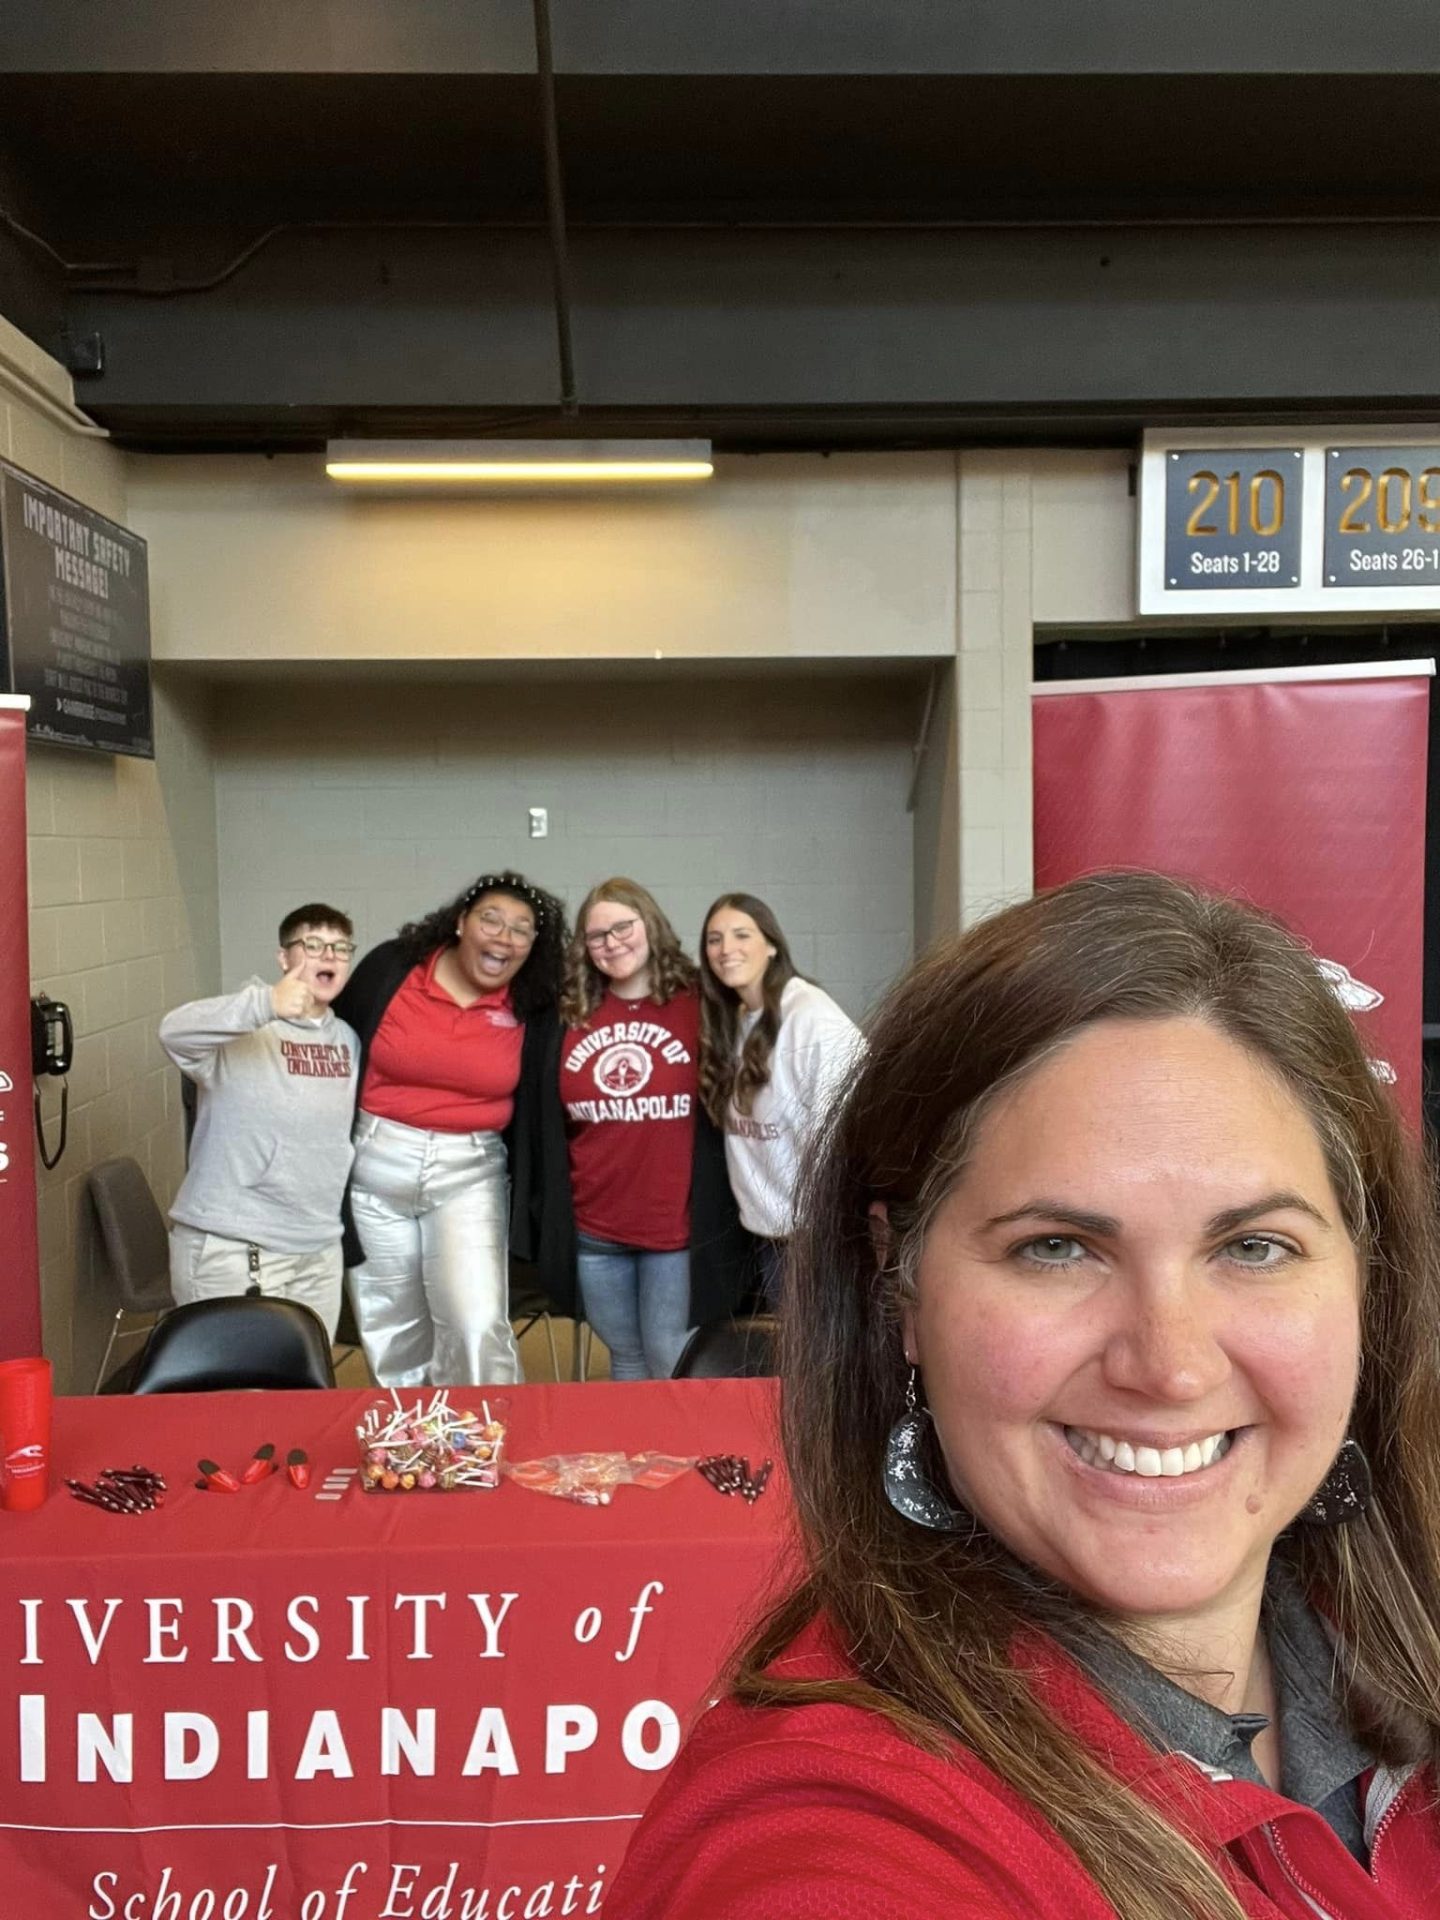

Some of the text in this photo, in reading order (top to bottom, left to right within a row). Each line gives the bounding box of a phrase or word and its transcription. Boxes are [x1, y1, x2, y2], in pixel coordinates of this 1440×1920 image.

[1186, 469, 1285, 536] 210
[1338, 466, 1440, 534] 209
[23, 493, 130, 578] IMPORTANT SAFETY
[1190, 551, 1281, 574] Seats 1-28
[1350, 548, 1439, 571] Seats 26-1
[565, 1021, 673, 1074] UNIVERSITY
[661, 1039, 692, 1065] OF
[567, 1093, 692, 1124] INDIANAPOLIS
[19, 1581, 665, 1665] IVERSITY of
[19, 1694, 720, 1783] INDIANAPO
[89, 1863, 278, 1920] School
[301, 1861, 368, 1920] of
